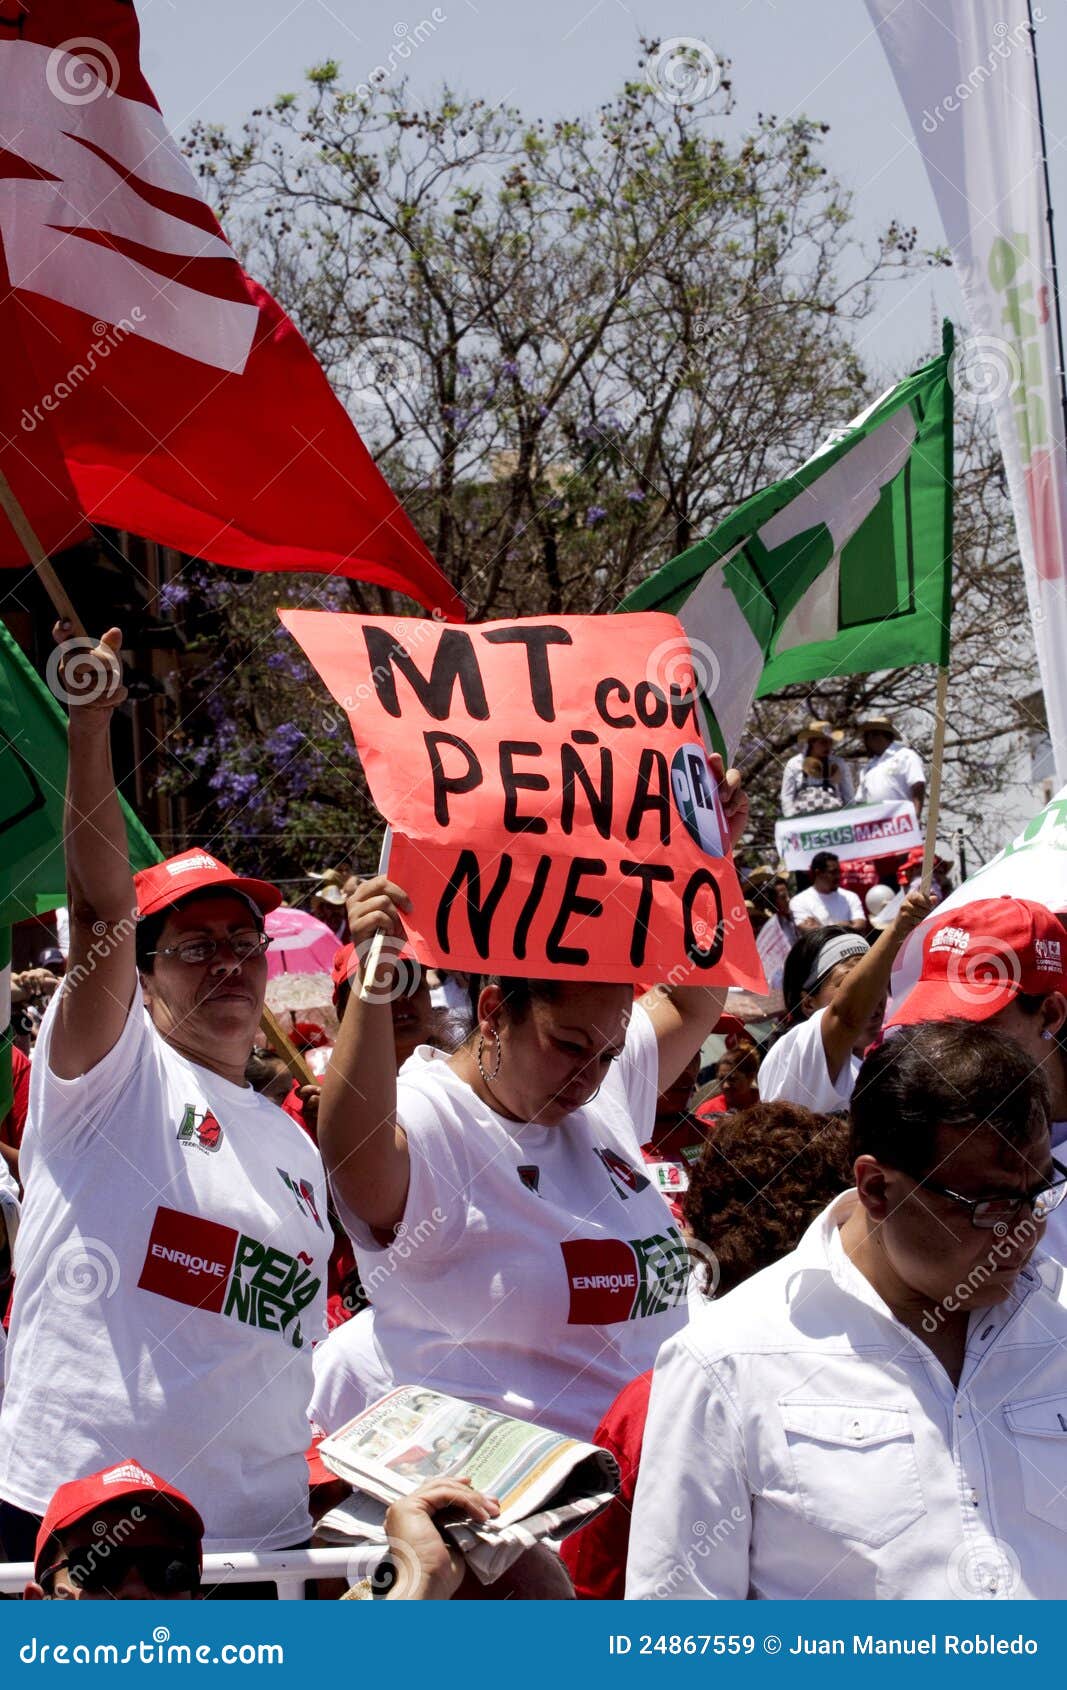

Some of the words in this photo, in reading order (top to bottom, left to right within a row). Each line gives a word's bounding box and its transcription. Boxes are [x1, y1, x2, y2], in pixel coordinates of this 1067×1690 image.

[362, 624, 573, 722] MT
[595, 677, 700, 737] con
[423, 729, 671, 847] PEÑA
[436, 849, 724, 970] NIETO
[151, 1243, 227, 1277] ENRIQUE
[572, 1274, 636, 1294] ENRIQUE
